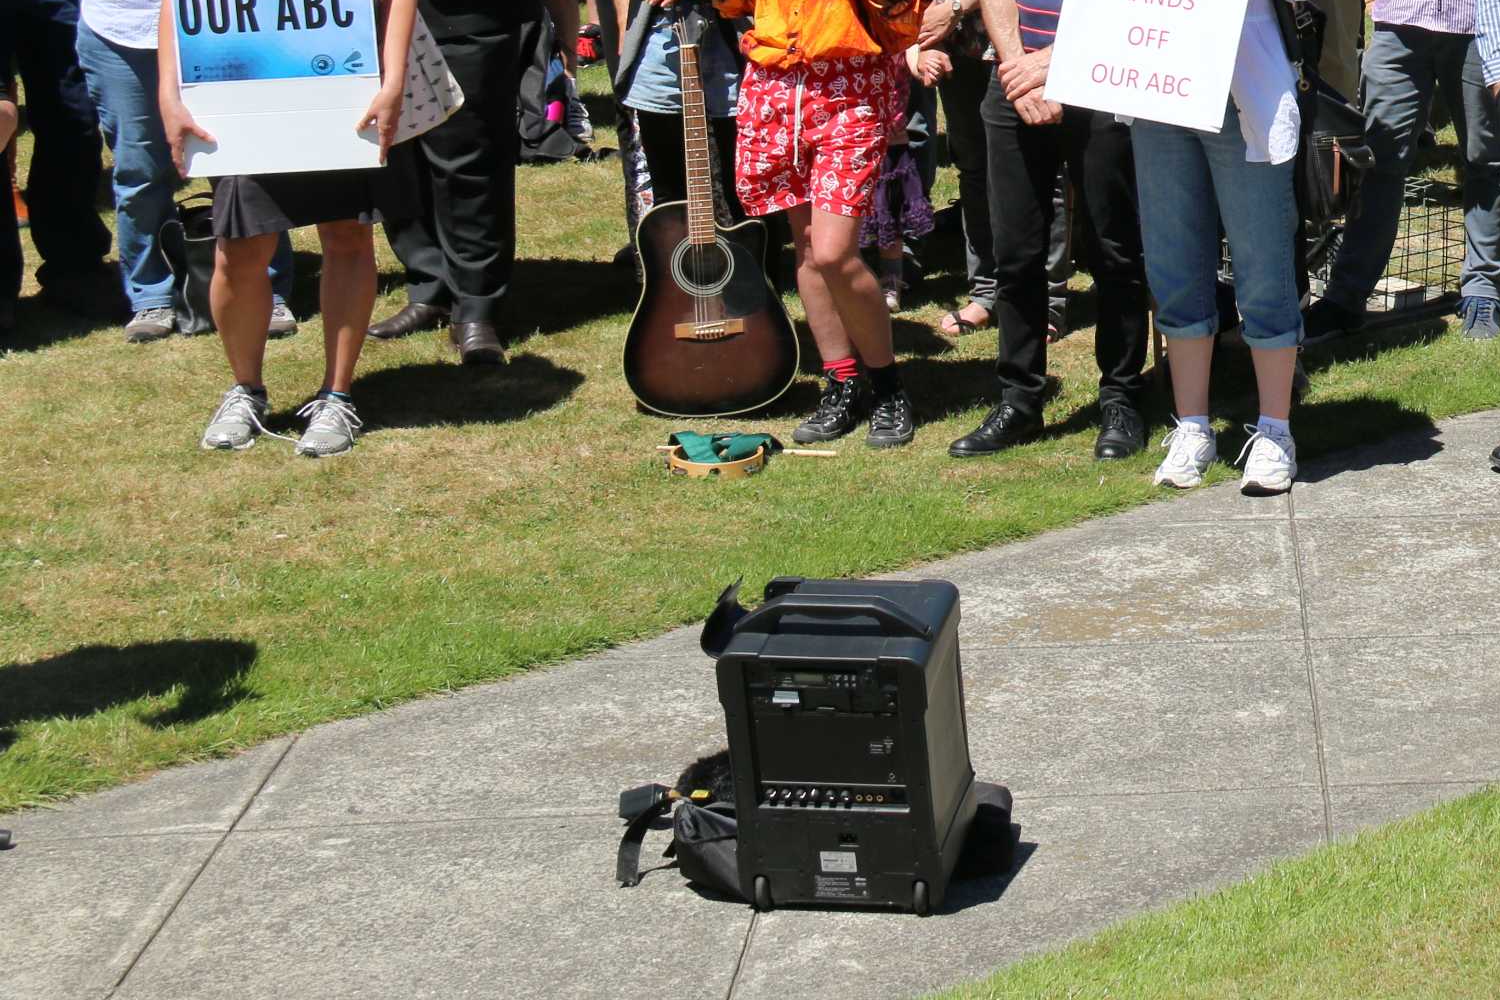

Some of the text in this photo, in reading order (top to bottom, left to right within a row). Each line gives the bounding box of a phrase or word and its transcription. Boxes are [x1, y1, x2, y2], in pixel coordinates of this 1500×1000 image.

[1127, 26, 1170, 49] OFF
[1091, 63, 1192, 97] OUR ABC
